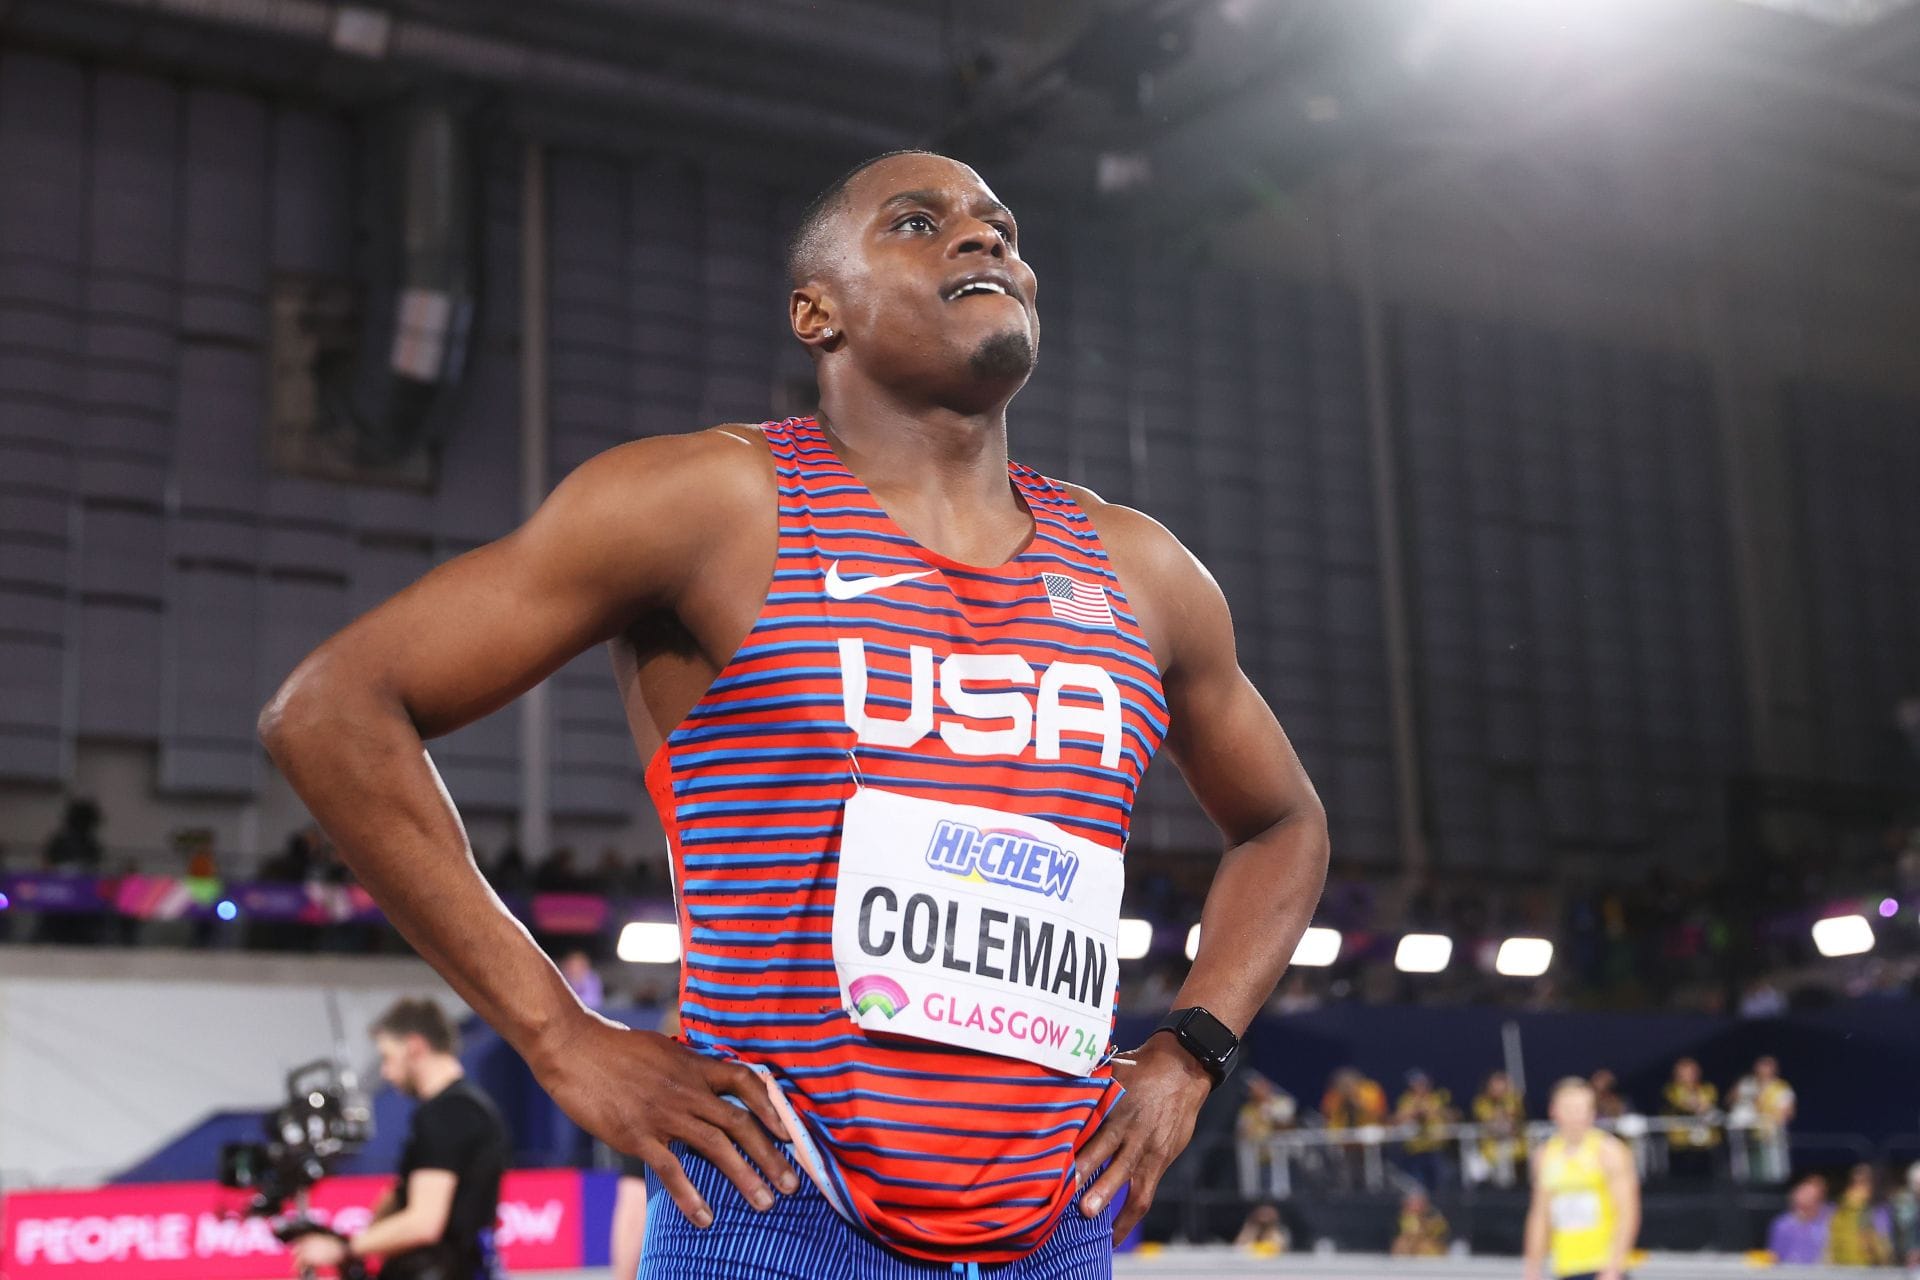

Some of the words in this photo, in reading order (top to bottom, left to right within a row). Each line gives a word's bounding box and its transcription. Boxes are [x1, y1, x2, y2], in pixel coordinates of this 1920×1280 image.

[838, 637, 1122, 770] USA
[926, 819, 1080, 902] HI-CHEW
[857, 886, 1107, 1009] COLEMAN
[922, 993, 1069, 1050] GLASGOW
[1070, 1028, 1097, 1061] 24
[15, 1212, 192, 1265] PEOPLE
